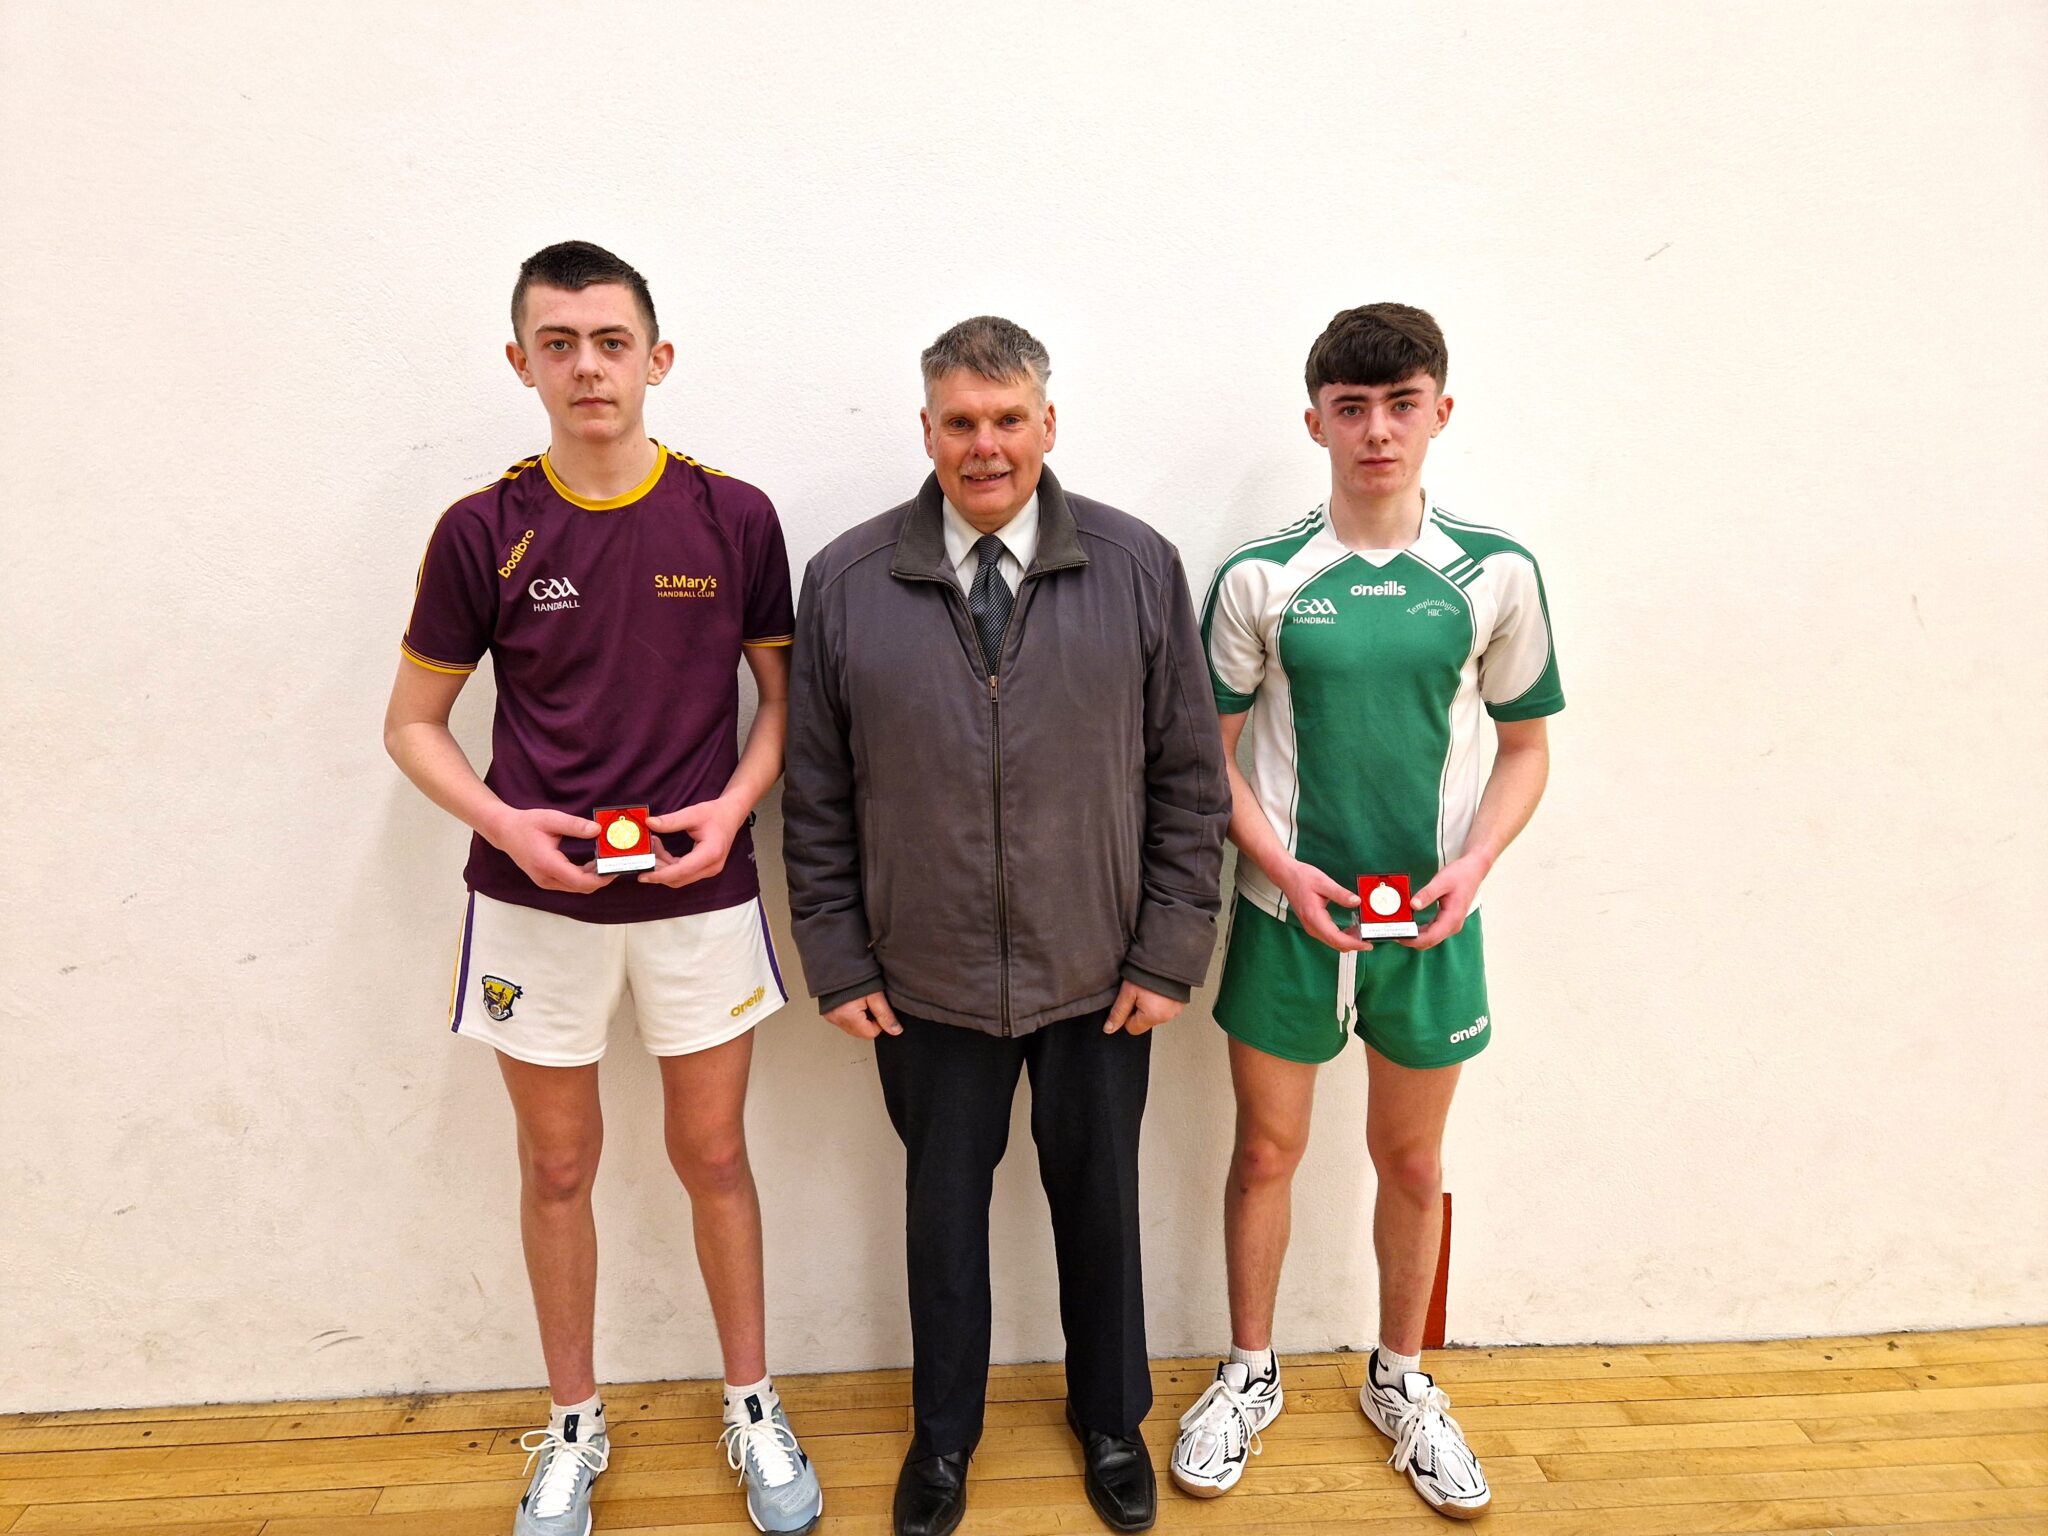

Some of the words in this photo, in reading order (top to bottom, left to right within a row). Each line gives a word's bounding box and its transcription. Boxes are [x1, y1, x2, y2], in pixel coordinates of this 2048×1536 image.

[498, 529, 535, 579] bodibro
[654, 574, 718, 592] St.Mary's
[533, 599, 581, 612] HANDBALL
[1427, 608, 1443, 617] HBC
[1293, 616, 1336, 625] HANDBALL
